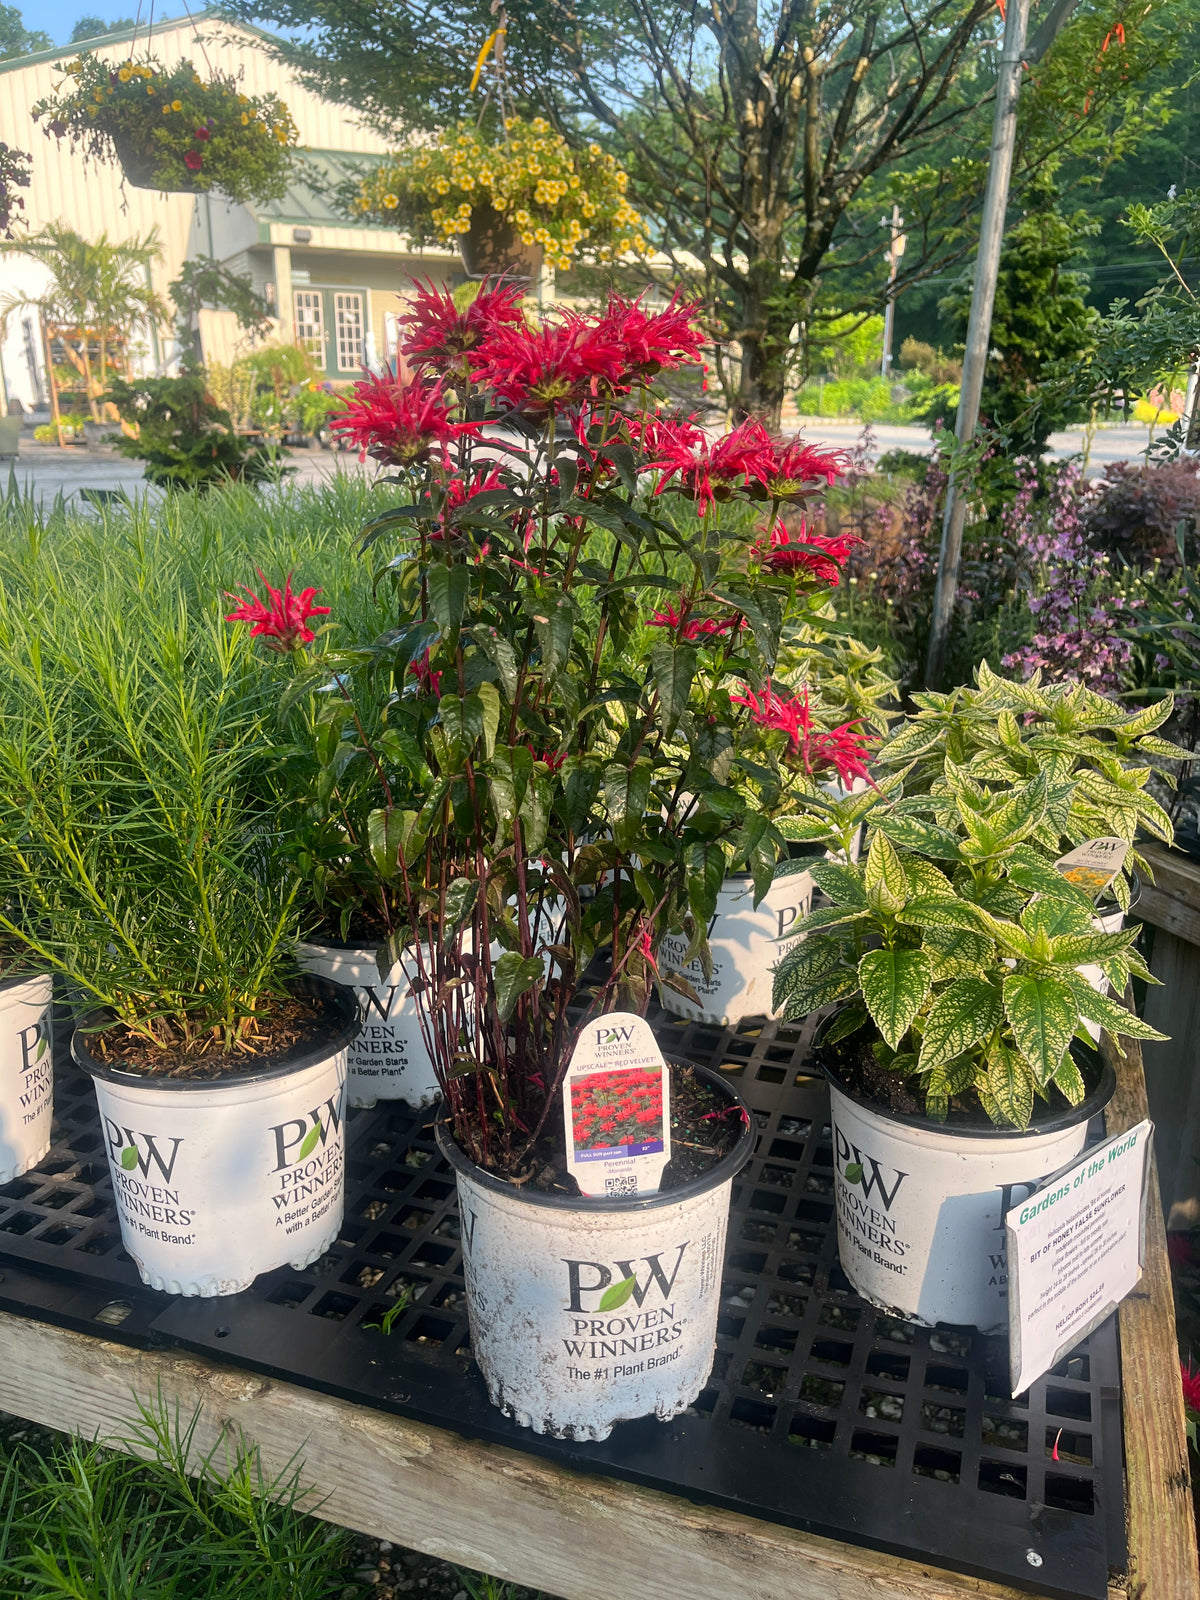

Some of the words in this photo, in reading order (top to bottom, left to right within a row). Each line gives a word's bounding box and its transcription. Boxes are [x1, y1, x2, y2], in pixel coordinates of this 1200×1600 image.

[360, 1026, 395, 1038] VEN
[595, 1025, 636, 1045] PW
[598, 1043, 632, 1052] PROVEN
[356, 1057, 383, 1066] Garden
[386, 1057, 408, 1066] Starts
[358, 1067, 380, 1076] Better
[23, 1110, 36, 1125] The
[280, 1136, 342, 1190] PROVEN
[604, 1158, 636, 1167] Perennial
[114, 1167, 180, 1206] PROVEN
[1020, 1184, 1069, 1224] Gardens
[1073, 1168, 1085, 1188] of
[1088, 1159, 1104, 1178] the
[1108, 1133, 1137, 1162] World
[275, 1215, 283, 1227] A
[284, 1205, 309, 1225] Better
[311, 1188, 334, 1210] Garden
[285, 1222, 303, 1236] with
[304, 1217, 311, 1227] a
[312, 1202, 330, 1222] Better
[1030, 1249, 1041, 1263] BIT
[1042, 1242, 1051, 1253] OF
[1052, 1226, 1073, 1246] HONEY
[1075, 1211, 1092, 1229] FALSE
[1094, 1184, 1125, 1214] SUNFLOWER
[140, 1223, 160, 1240] Plant
[560, 1241, 690, 1313] PW
[573, 1303, 675, 1337] PROVEN
[566, 1366, 591, 1380] The
[594, 1367, 609, 1380] #1
[614, 1360, 644, 1379] Plant
